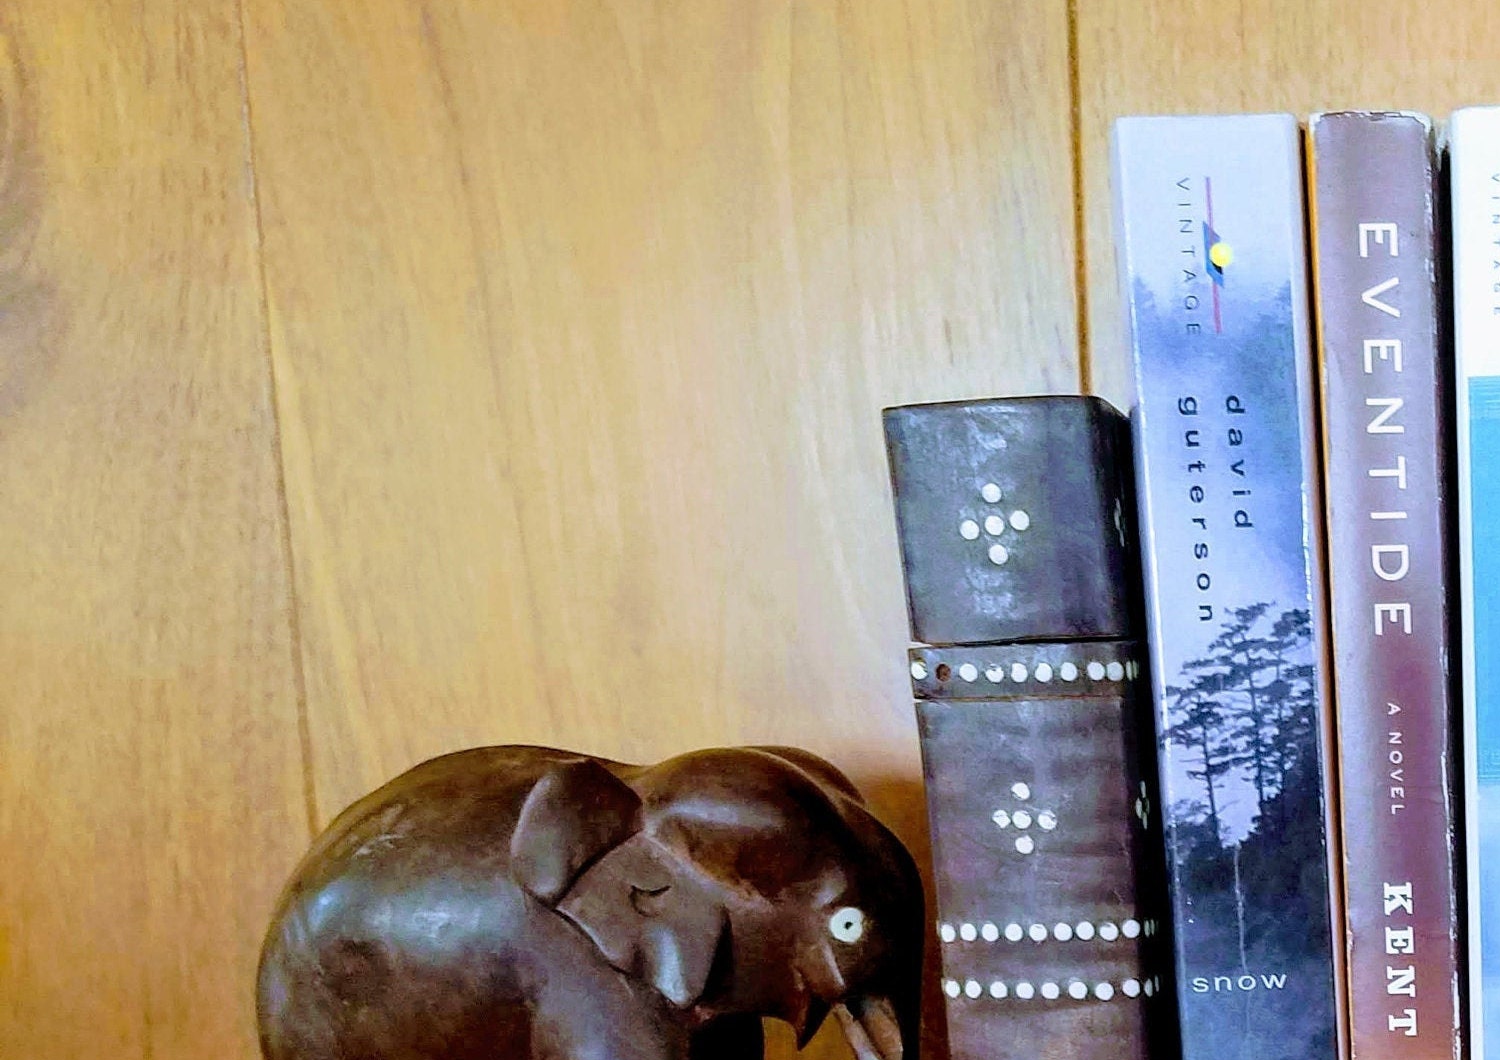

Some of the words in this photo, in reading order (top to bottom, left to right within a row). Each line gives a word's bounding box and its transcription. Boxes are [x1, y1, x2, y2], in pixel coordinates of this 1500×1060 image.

[1176, 177, 1200, 336] VINTAGE
[1226, 395, 1253, 529] david
[1358, 222, 1412, 636] EVENTIDE
[1178, 396, 1213, 622] guterson
[1387, 703, 1401, 715] A
[1387, 731, 1404, 815] NOVEL
[1191, 973, 1288, 993] snow
[1384, 881, 1418, 1036] KENT
